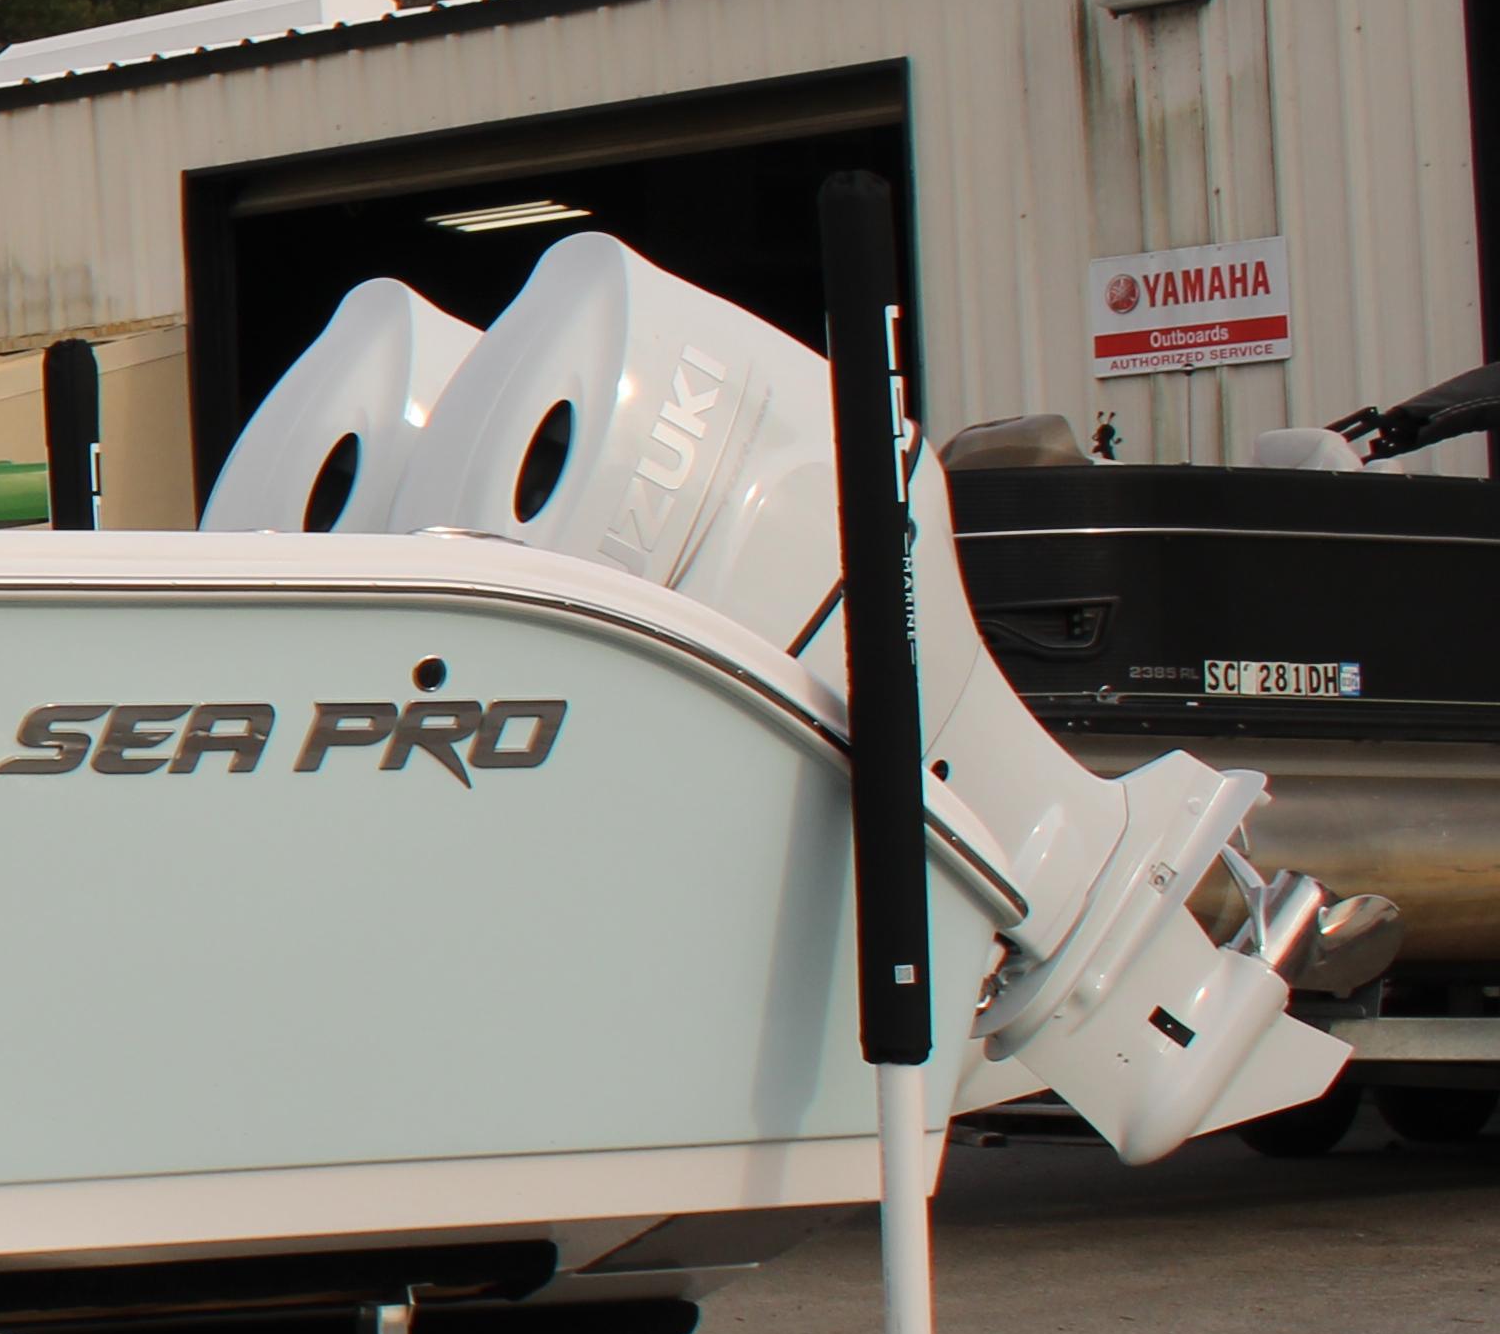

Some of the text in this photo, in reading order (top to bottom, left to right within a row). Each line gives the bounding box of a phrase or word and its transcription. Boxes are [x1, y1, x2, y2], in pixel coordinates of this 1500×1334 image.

[1142, 261, 1271, 307] YAMAHA
[1150, 325, 1229, 347] Outboards
[1110, 344, 1274, 371] AUTHORIZED SERVICE
[901, 557, 916, 641] MARINE
[1129, 666, 1177, 679] 2385
[1207, 662, 1236, 691] SC
[292, 699, 568, 789] PRO
